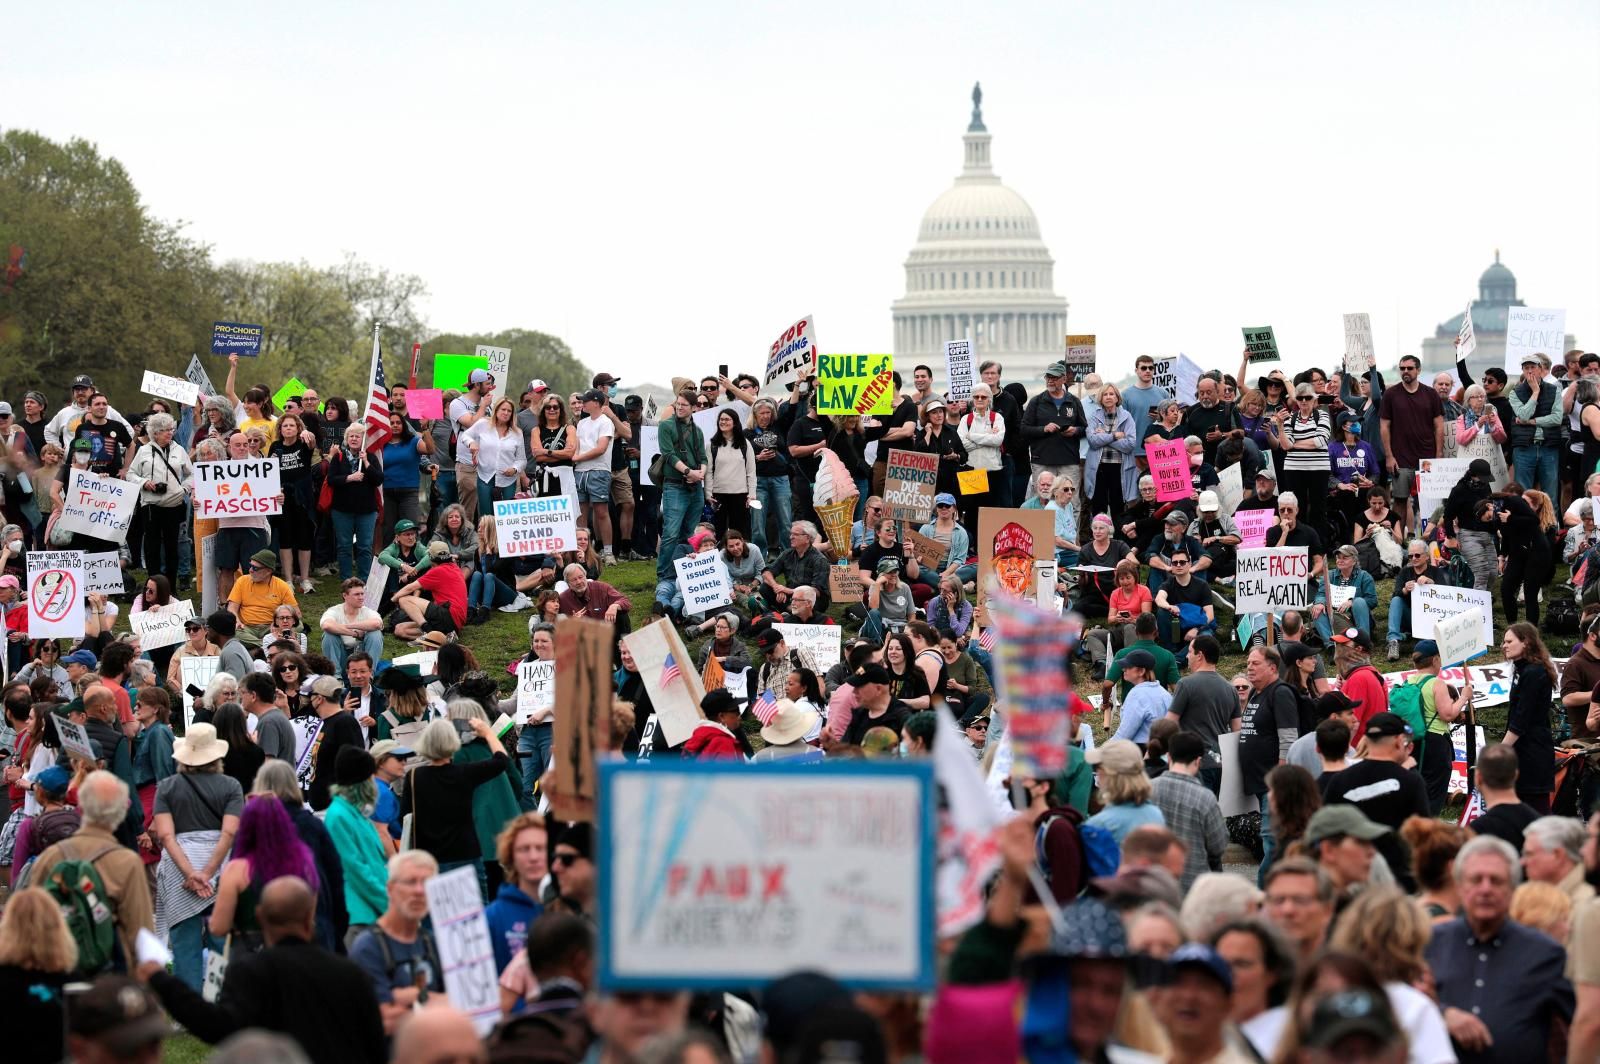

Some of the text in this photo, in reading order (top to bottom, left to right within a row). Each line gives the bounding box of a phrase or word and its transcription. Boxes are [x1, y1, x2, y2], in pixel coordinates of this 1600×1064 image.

[214, 325, 261, 335] PRO-CHOICE
[1244, 331, 1272, 342] WE NEED
[1509, 327, 1565, 350] SCIENCE
[771, 320, 808, 359] STOP
[818, 354, 889, 379] RULE of
[1153, 361, 1170, 375] TOP
[153, 374, 195, 392] PEOPLE
[818, 384, 859, 409] LAW
[854, 370, 893, 415] MATTERS
[890, 452, 937, 471] EVERYONE
[197, 462, 273, 481] TRUMP
[887, 467, 936, 485] DESERVES
[1158, 468, 1181, 479] YOU'RE
[76, 473, 123, 497] Remove
[217, 482, 252, 496] IS A
[901, 481, 921, 495] DUE
[80, 491, 116, 512] Trump
[204, 496, 280, 515] FASCIST
[497, 498, 569, 516] DIVERSITY
[885, 490, 931, 509] PROCESS
[65, 504, 85, 517] from
[497, 511, 572, 527] IS OUR STRENGTH
[916, 509, 932, 521] WHAT
[513, 527, 553, 541] STAND
[506, 537, 565, 554] UNITED
[72, 559, 82, 569] GO
[83, 558, 119, 570] ORTION
[681, 555, 716, 570] So many
[832, 565, 852, 575] Stop
[1237, 554, 1308, 578] MAKE FACTS
[88, 572, 97, 580] IS
[694, 593, 720, 605] paper
[1238, 578, 1268, 598] REAL
[1266, 583, 1307, 608] AGAIN
[524, 680, 547, 693] OFF
[665, 862, 788, 899] FAUX
